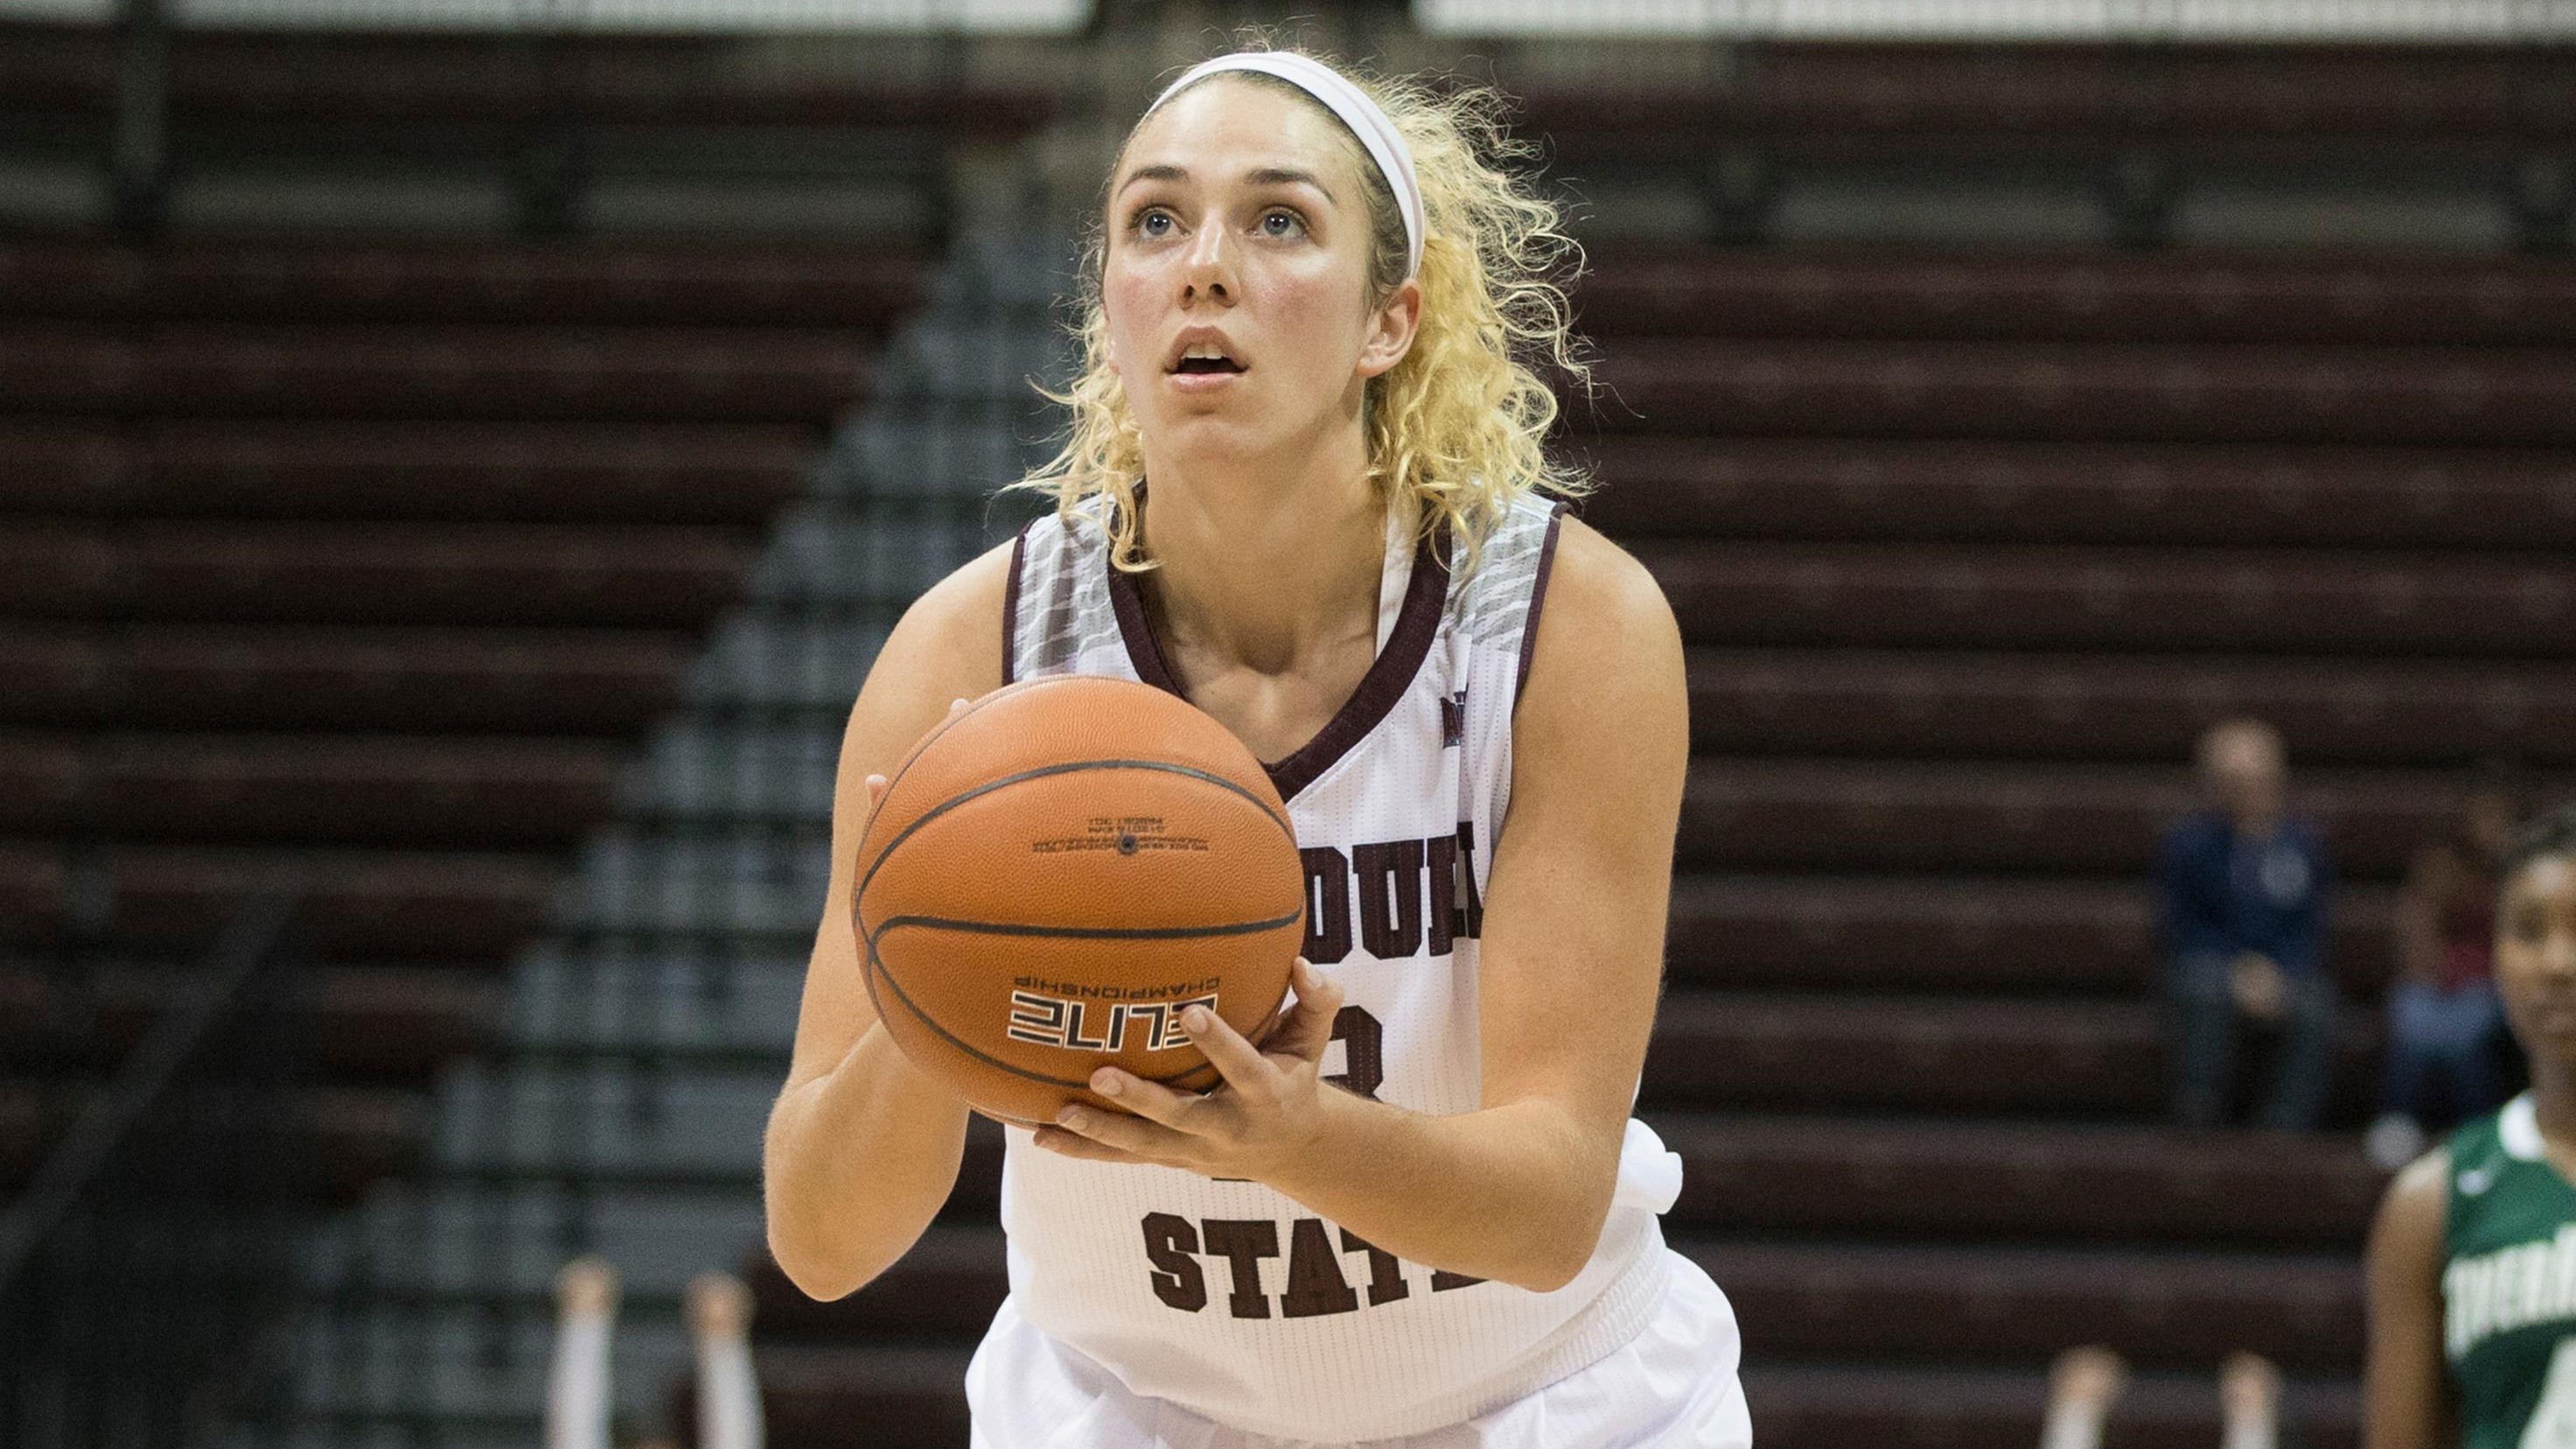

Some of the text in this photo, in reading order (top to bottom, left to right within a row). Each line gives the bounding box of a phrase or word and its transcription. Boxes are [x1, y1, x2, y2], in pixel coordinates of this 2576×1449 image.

[1014, 975, 1221, 1000] CHAMPIONSHIP
[1008, 990, 1218, 1053] ELITE
[1141, 1211, 1490, 1319] STAT
